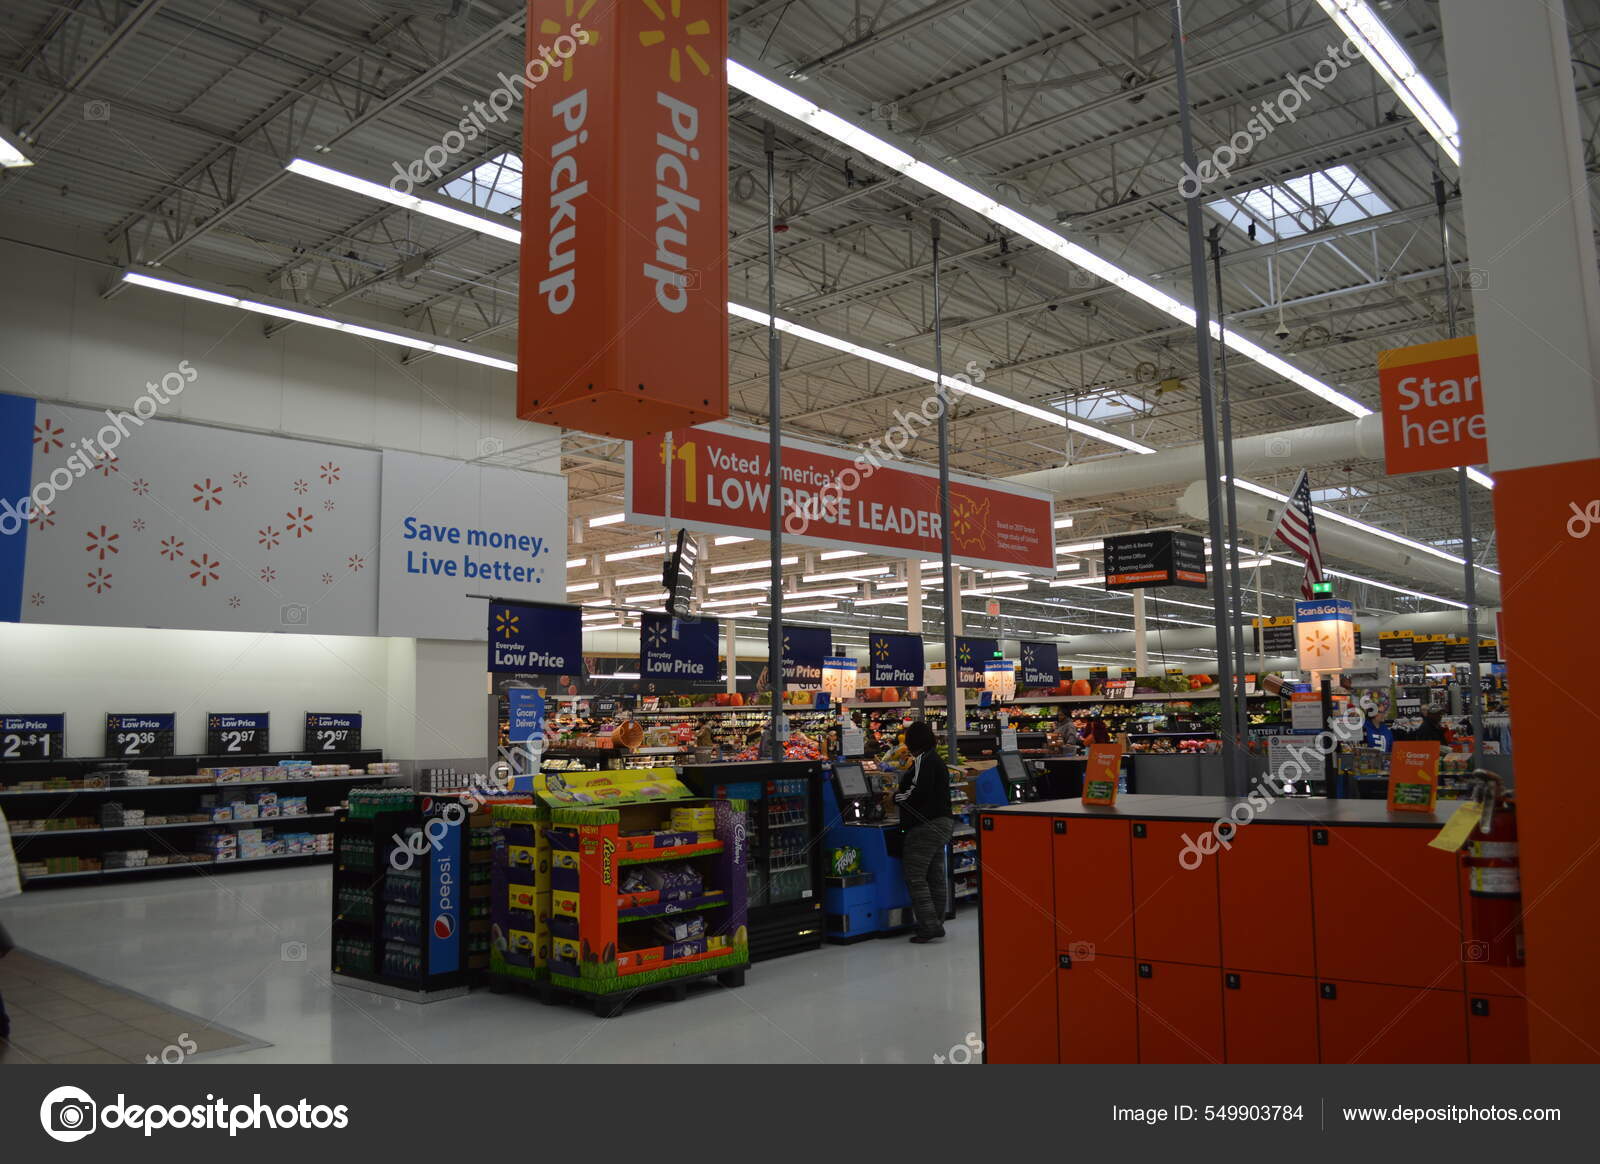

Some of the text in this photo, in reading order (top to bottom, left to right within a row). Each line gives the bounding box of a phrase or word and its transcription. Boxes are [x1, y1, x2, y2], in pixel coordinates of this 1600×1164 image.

[539, 88, 588, 315] Pickup
[643, 91, 700, 313] Pickup
[1398, 376, 1478, 411] Star
[1402, 414, 1488, 448] here
[707, 446, 760, 475] Voted
[765, 461, 841, 489] merica's
[707, 474, 943, 539] LOW PRICE LEADER
[403, 516, 549, 558] Save money.
[407, 551, 541, 584] Live better.
[495, 642, 525, 651] Everyday
[495, 651, 565, 668] Low Price
[647, 651, 671, 660] Everyday
[647, 659, 704, 674] Low Price
[781, 665, 821, 679] ow Price
[876, 669, 914, 682] Low Price
[960, 671, 985, 683] Low Pri
[1025, 673, 1053, 683] Low Price
[26, 720, 48, 729] Price
[122, 720, 139, 728] Low
[140, 720, 160, 728] Price
[222, 719, 237, 727] Low
[238, 719, 256, 727] Price
[319, 719, 350, 727] Low Price
[4, 734, 21, 757] 2
[439, 857, 454, 910] pepsi
